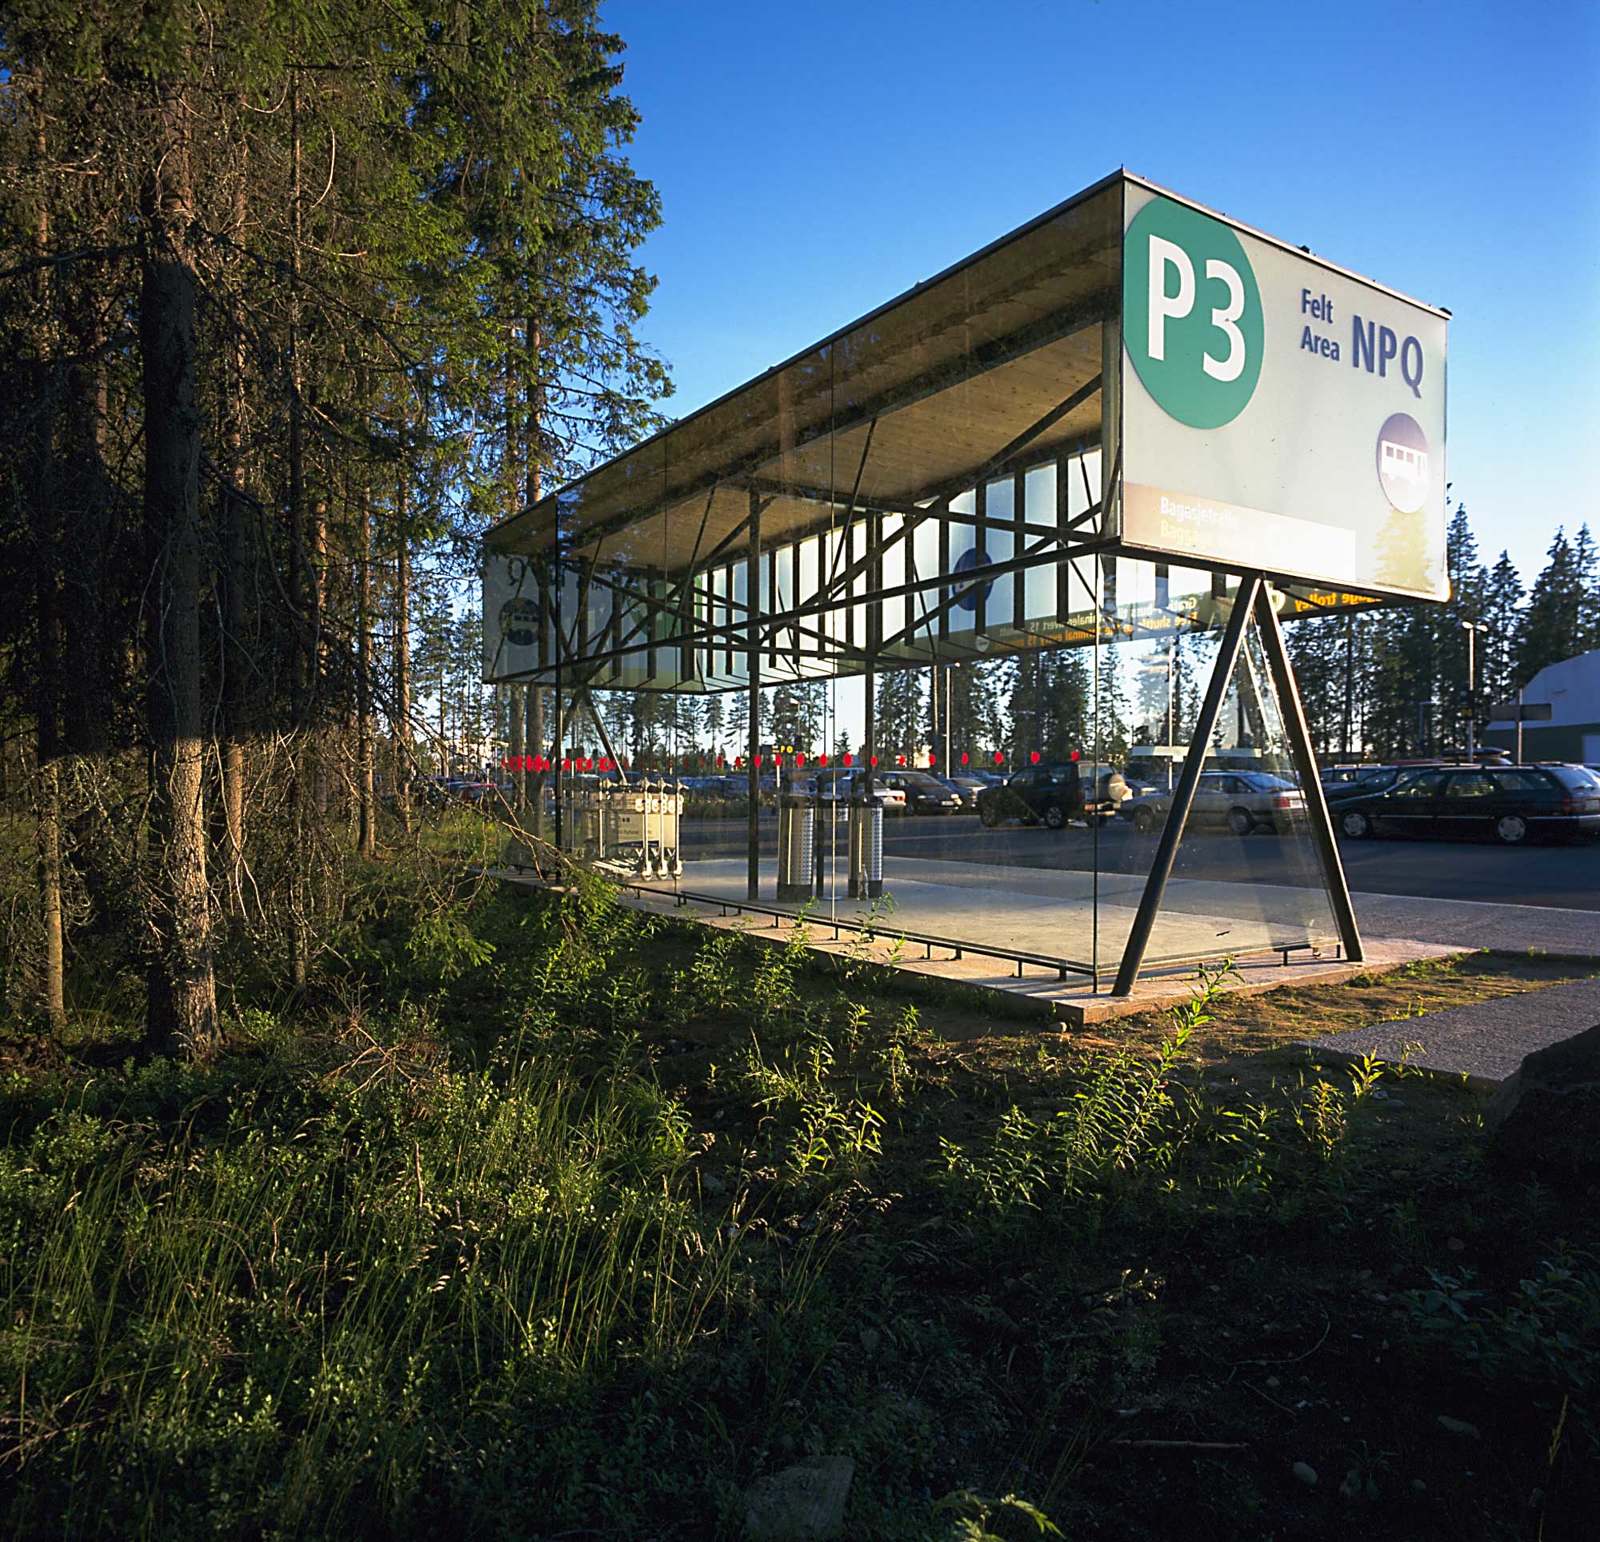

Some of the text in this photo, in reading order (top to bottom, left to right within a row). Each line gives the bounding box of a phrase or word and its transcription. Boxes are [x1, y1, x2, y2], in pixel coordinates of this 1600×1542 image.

[1148, 233, 1246, 382] P3
[1300, 287, 1334, 325] Felt
[1300, 325, 1340, 361] Area
[1352, 315, 1424, 399] NPQ
